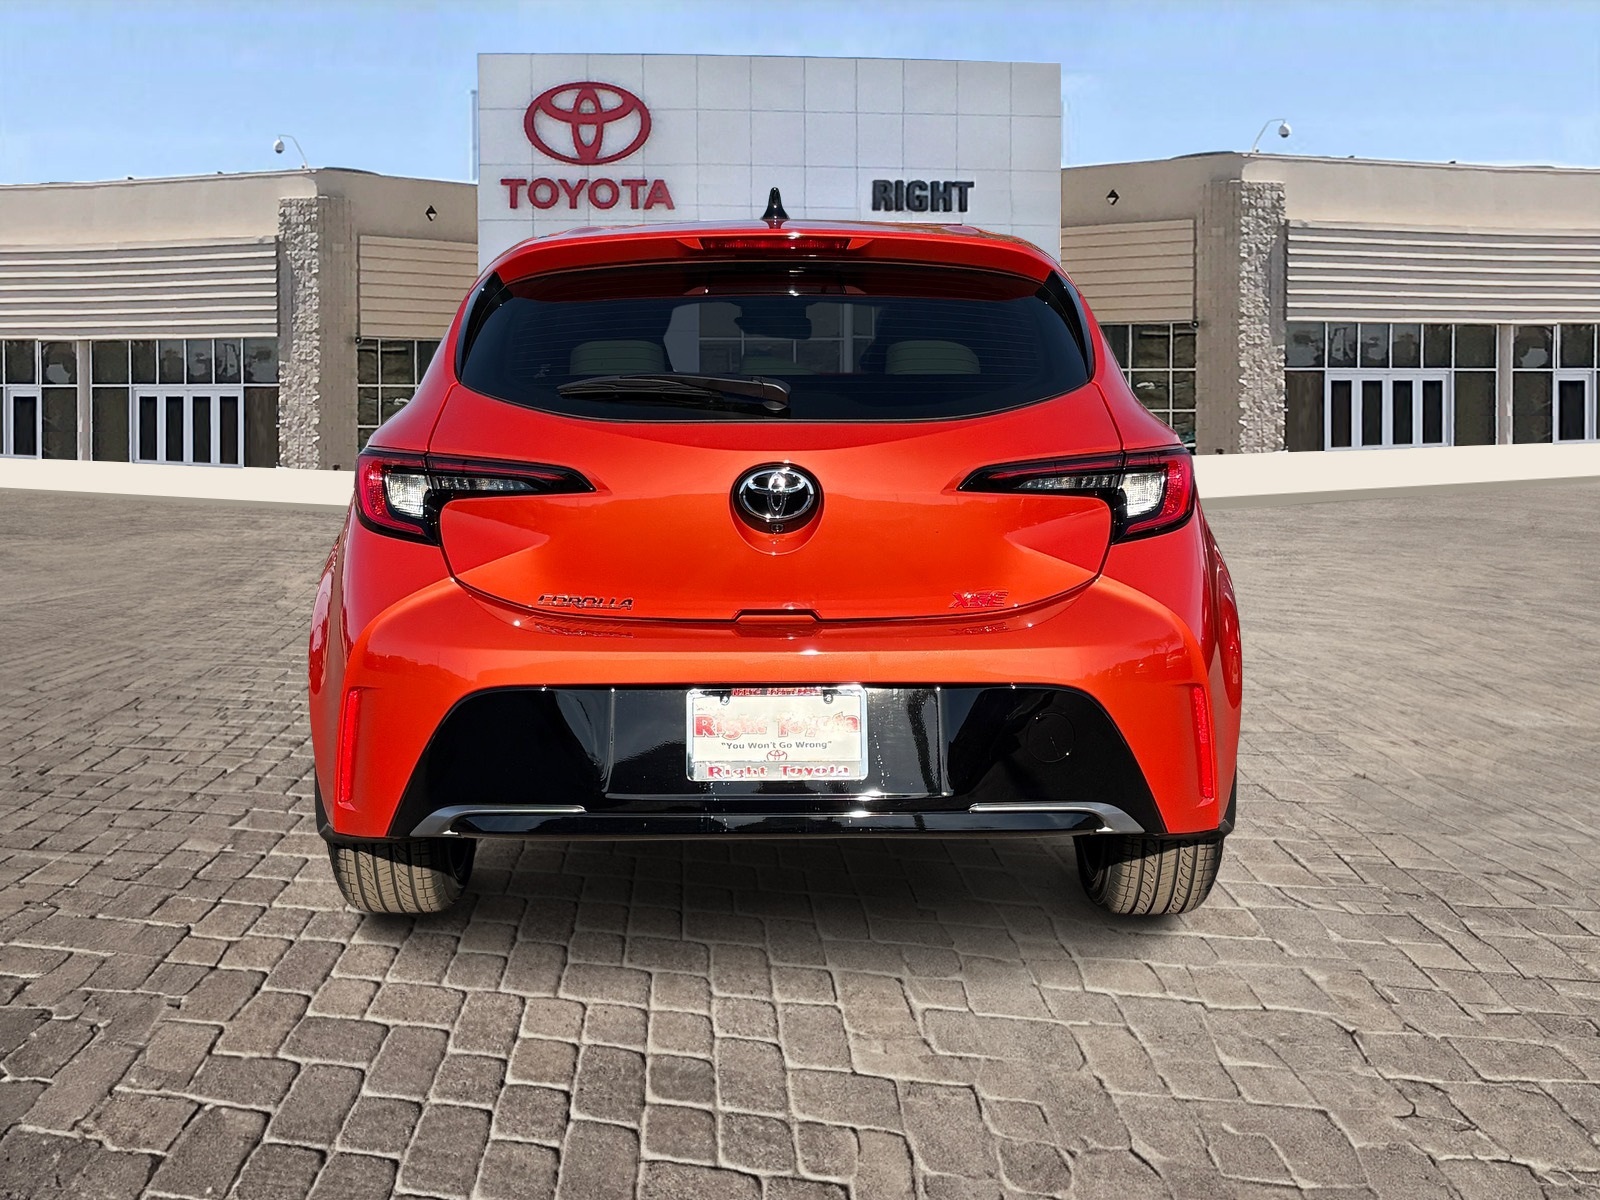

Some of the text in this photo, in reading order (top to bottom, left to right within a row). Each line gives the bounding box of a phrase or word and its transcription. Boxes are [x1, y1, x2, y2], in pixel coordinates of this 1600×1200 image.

[500, 178, 675, 210] TOYOTA
[872, 179, 975, 213] RIGHT
[537, 594, 635, 611] COROLLA
[747, 741, 777, 749] Won't
[779, 741, 793, 749] Go
[707, 764, 850, 779] Right Toyota
